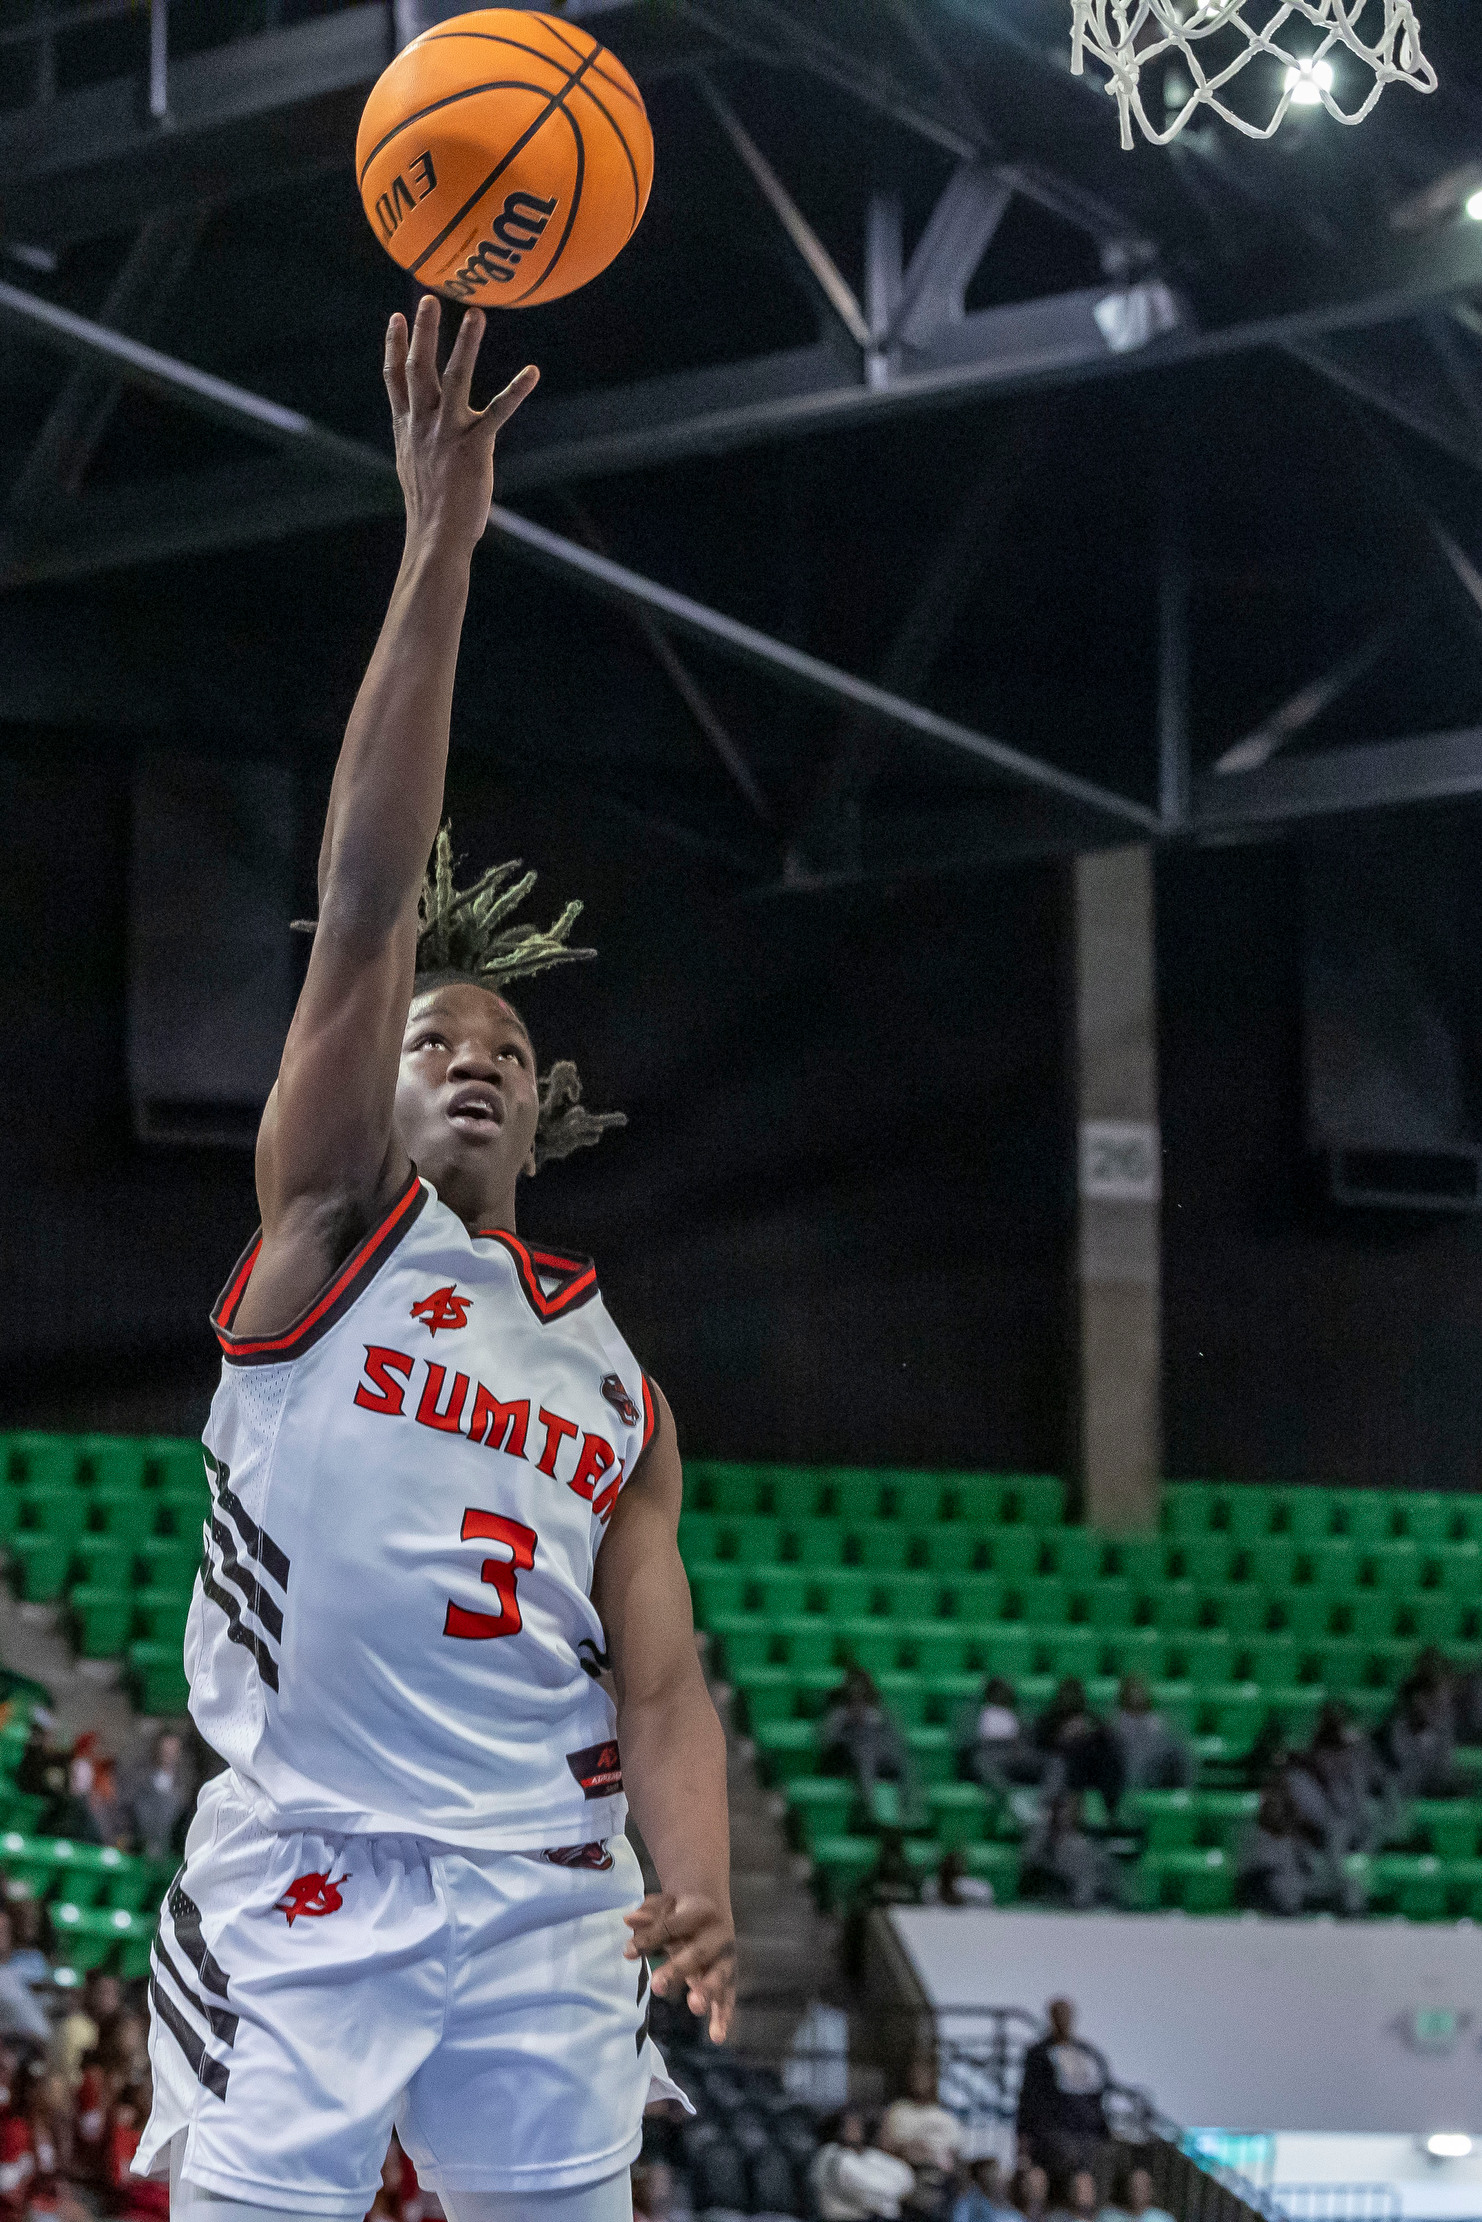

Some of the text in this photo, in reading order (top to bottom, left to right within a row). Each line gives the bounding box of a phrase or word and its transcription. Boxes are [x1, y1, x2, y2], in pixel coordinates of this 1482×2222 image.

[375, 150, 438, 242] EVO
[444, 191, 560, 298] Wilso
[442, 1507, 538, 1640] 3
